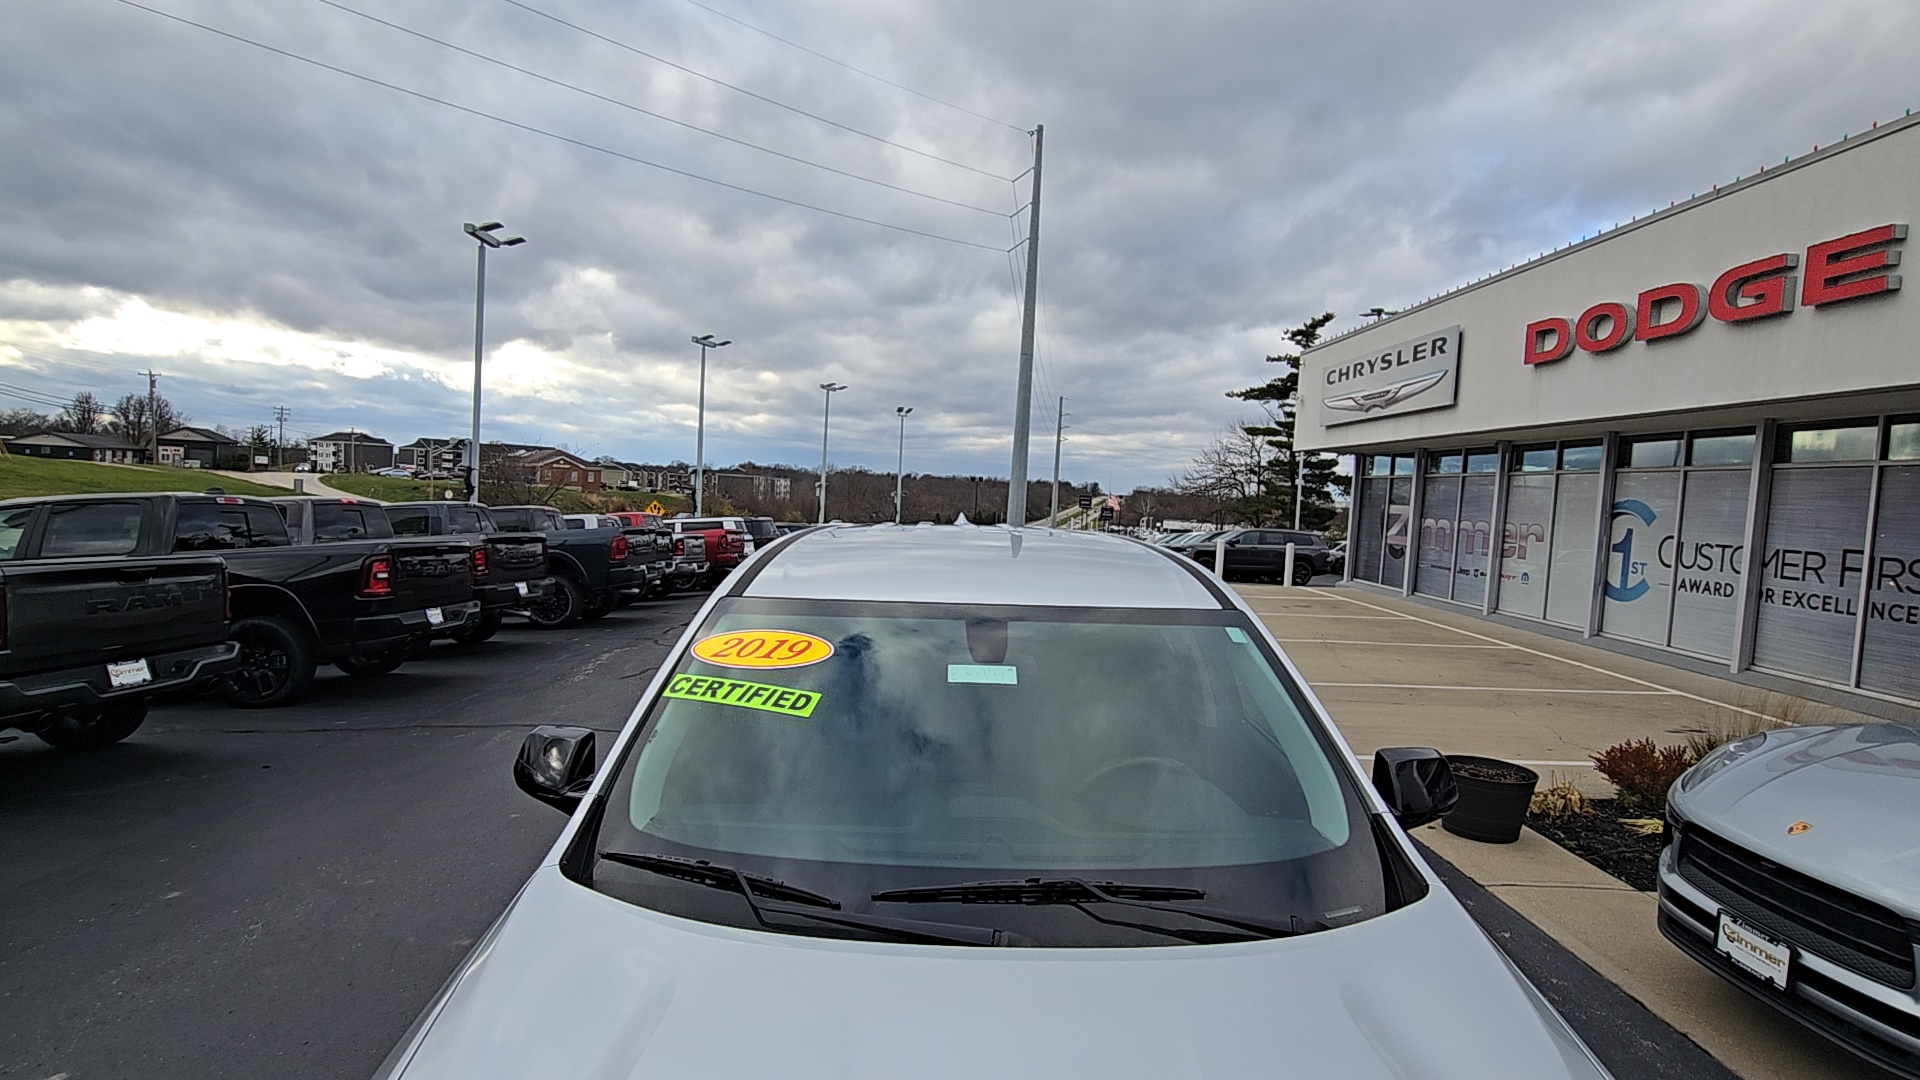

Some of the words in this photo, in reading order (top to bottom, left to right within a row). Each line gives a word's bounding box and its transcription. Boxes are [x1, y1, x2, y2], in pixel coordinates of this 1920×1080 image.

[1524, 224, 1908, 366] DODGE
[1326, 337, 1448, 386] CHRYSLER
[1386, 504, 1545, 560] Zmmer
[86, 592, 183, 615] RAM
[1677, 578, 1734, 598] AWARD
[1782, 589, 1920, 625] EXCELLNCE
[710, 637, 813, 660] 2019
[669, 677, 813, 711] CERTIFIED
[1723, 923, 1786, 968] Zimmer
